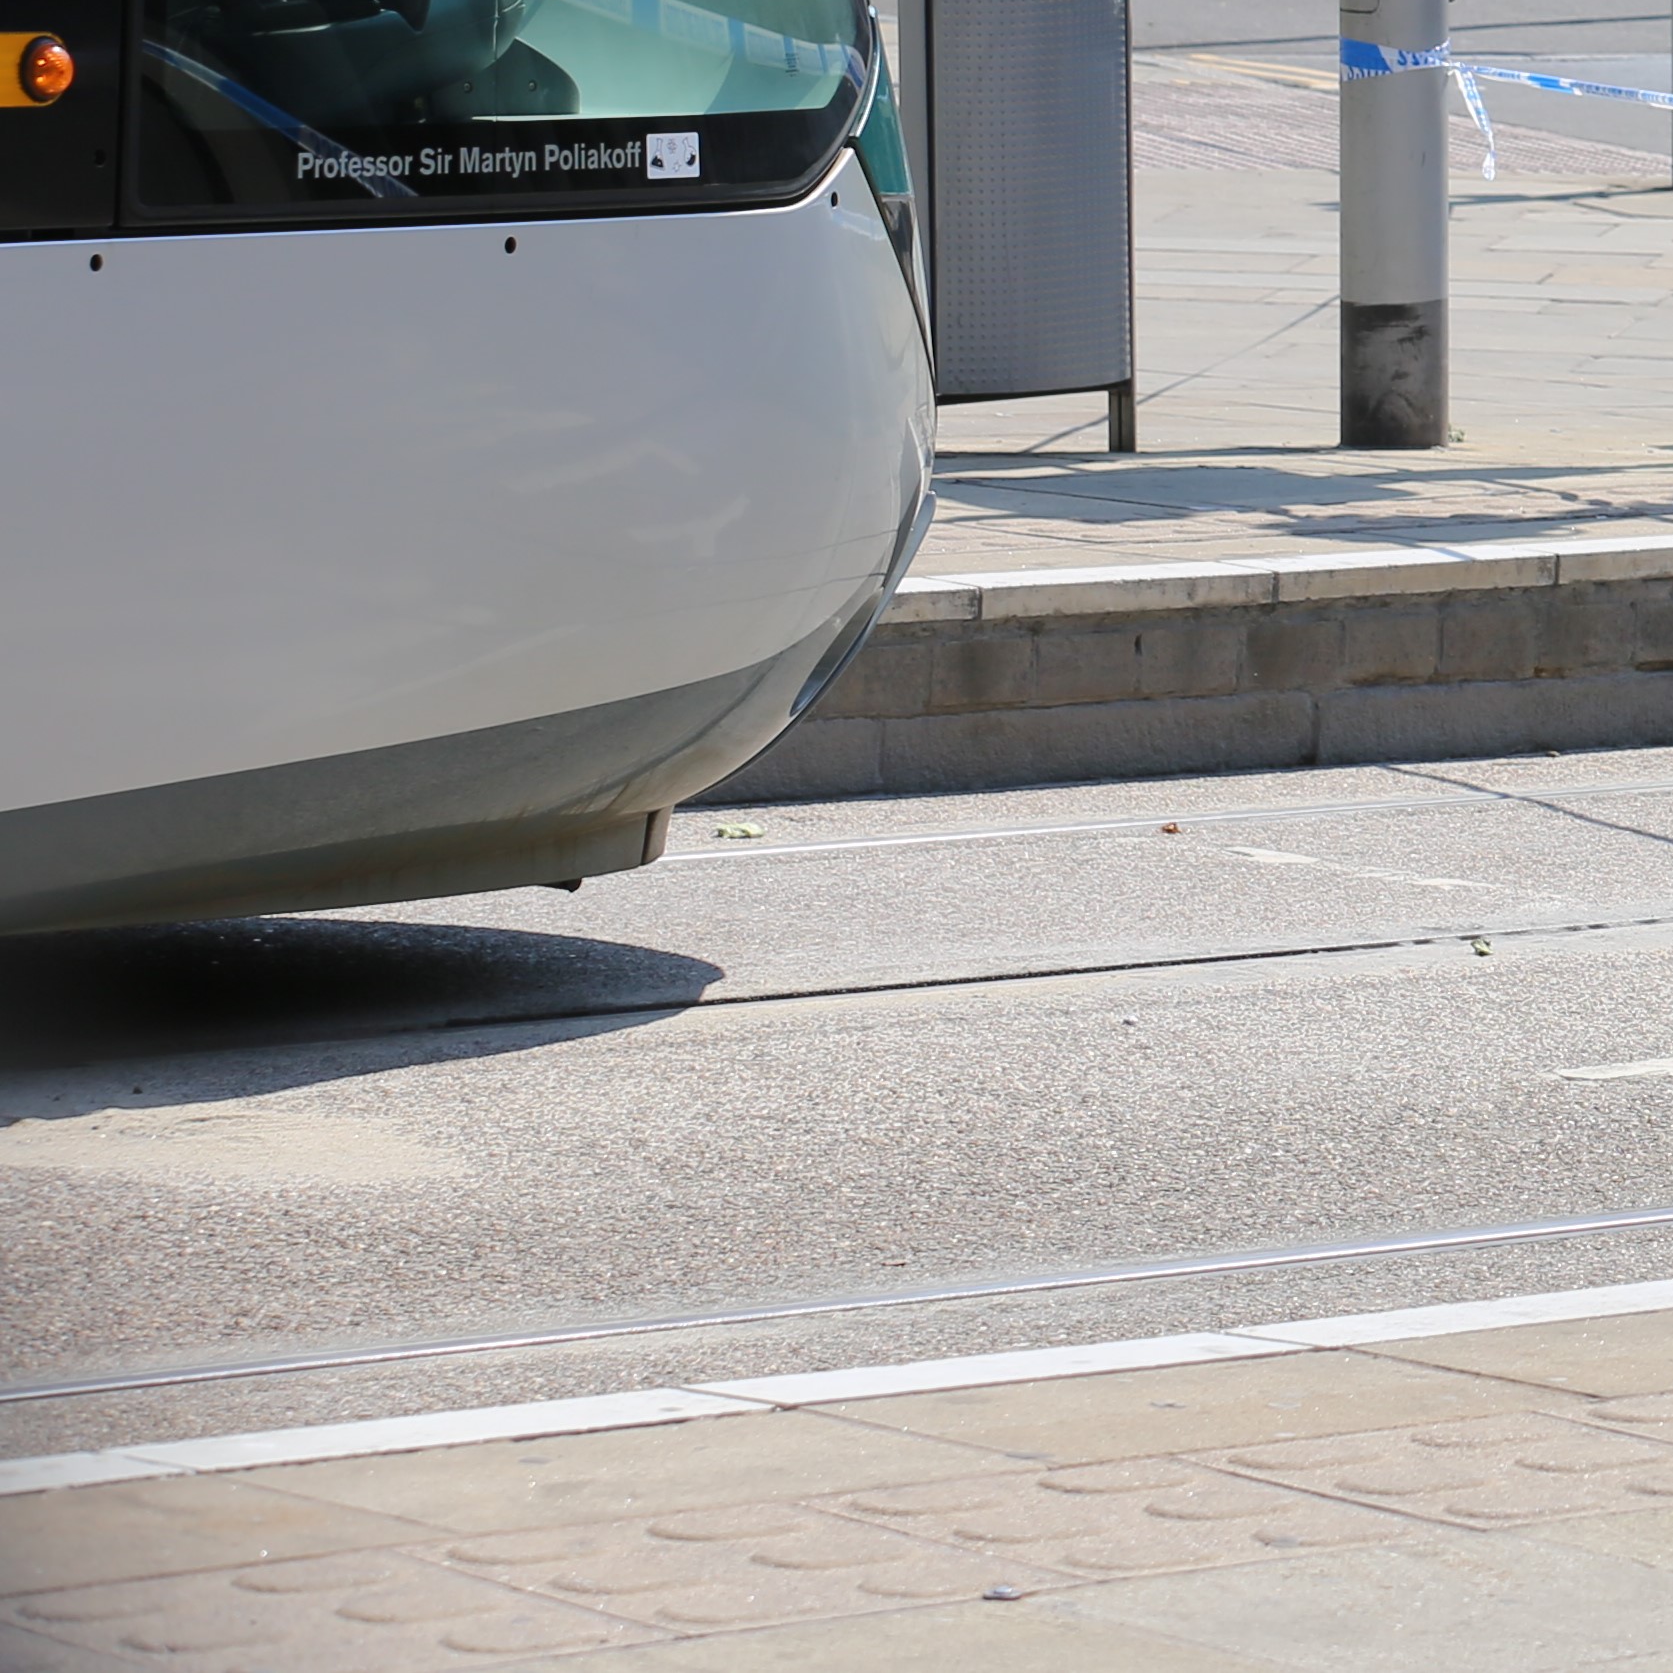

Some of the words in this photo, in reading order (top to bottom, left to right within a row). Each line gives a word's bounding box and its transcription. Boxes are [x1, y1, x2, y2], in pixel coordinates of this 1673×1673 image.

[297, 149, 413, 179] Professor
[419, 147, 452, 176] Sir
[459, 145, 537, 178] Martyn
[544, 141, 642, 172] Poliakoff
